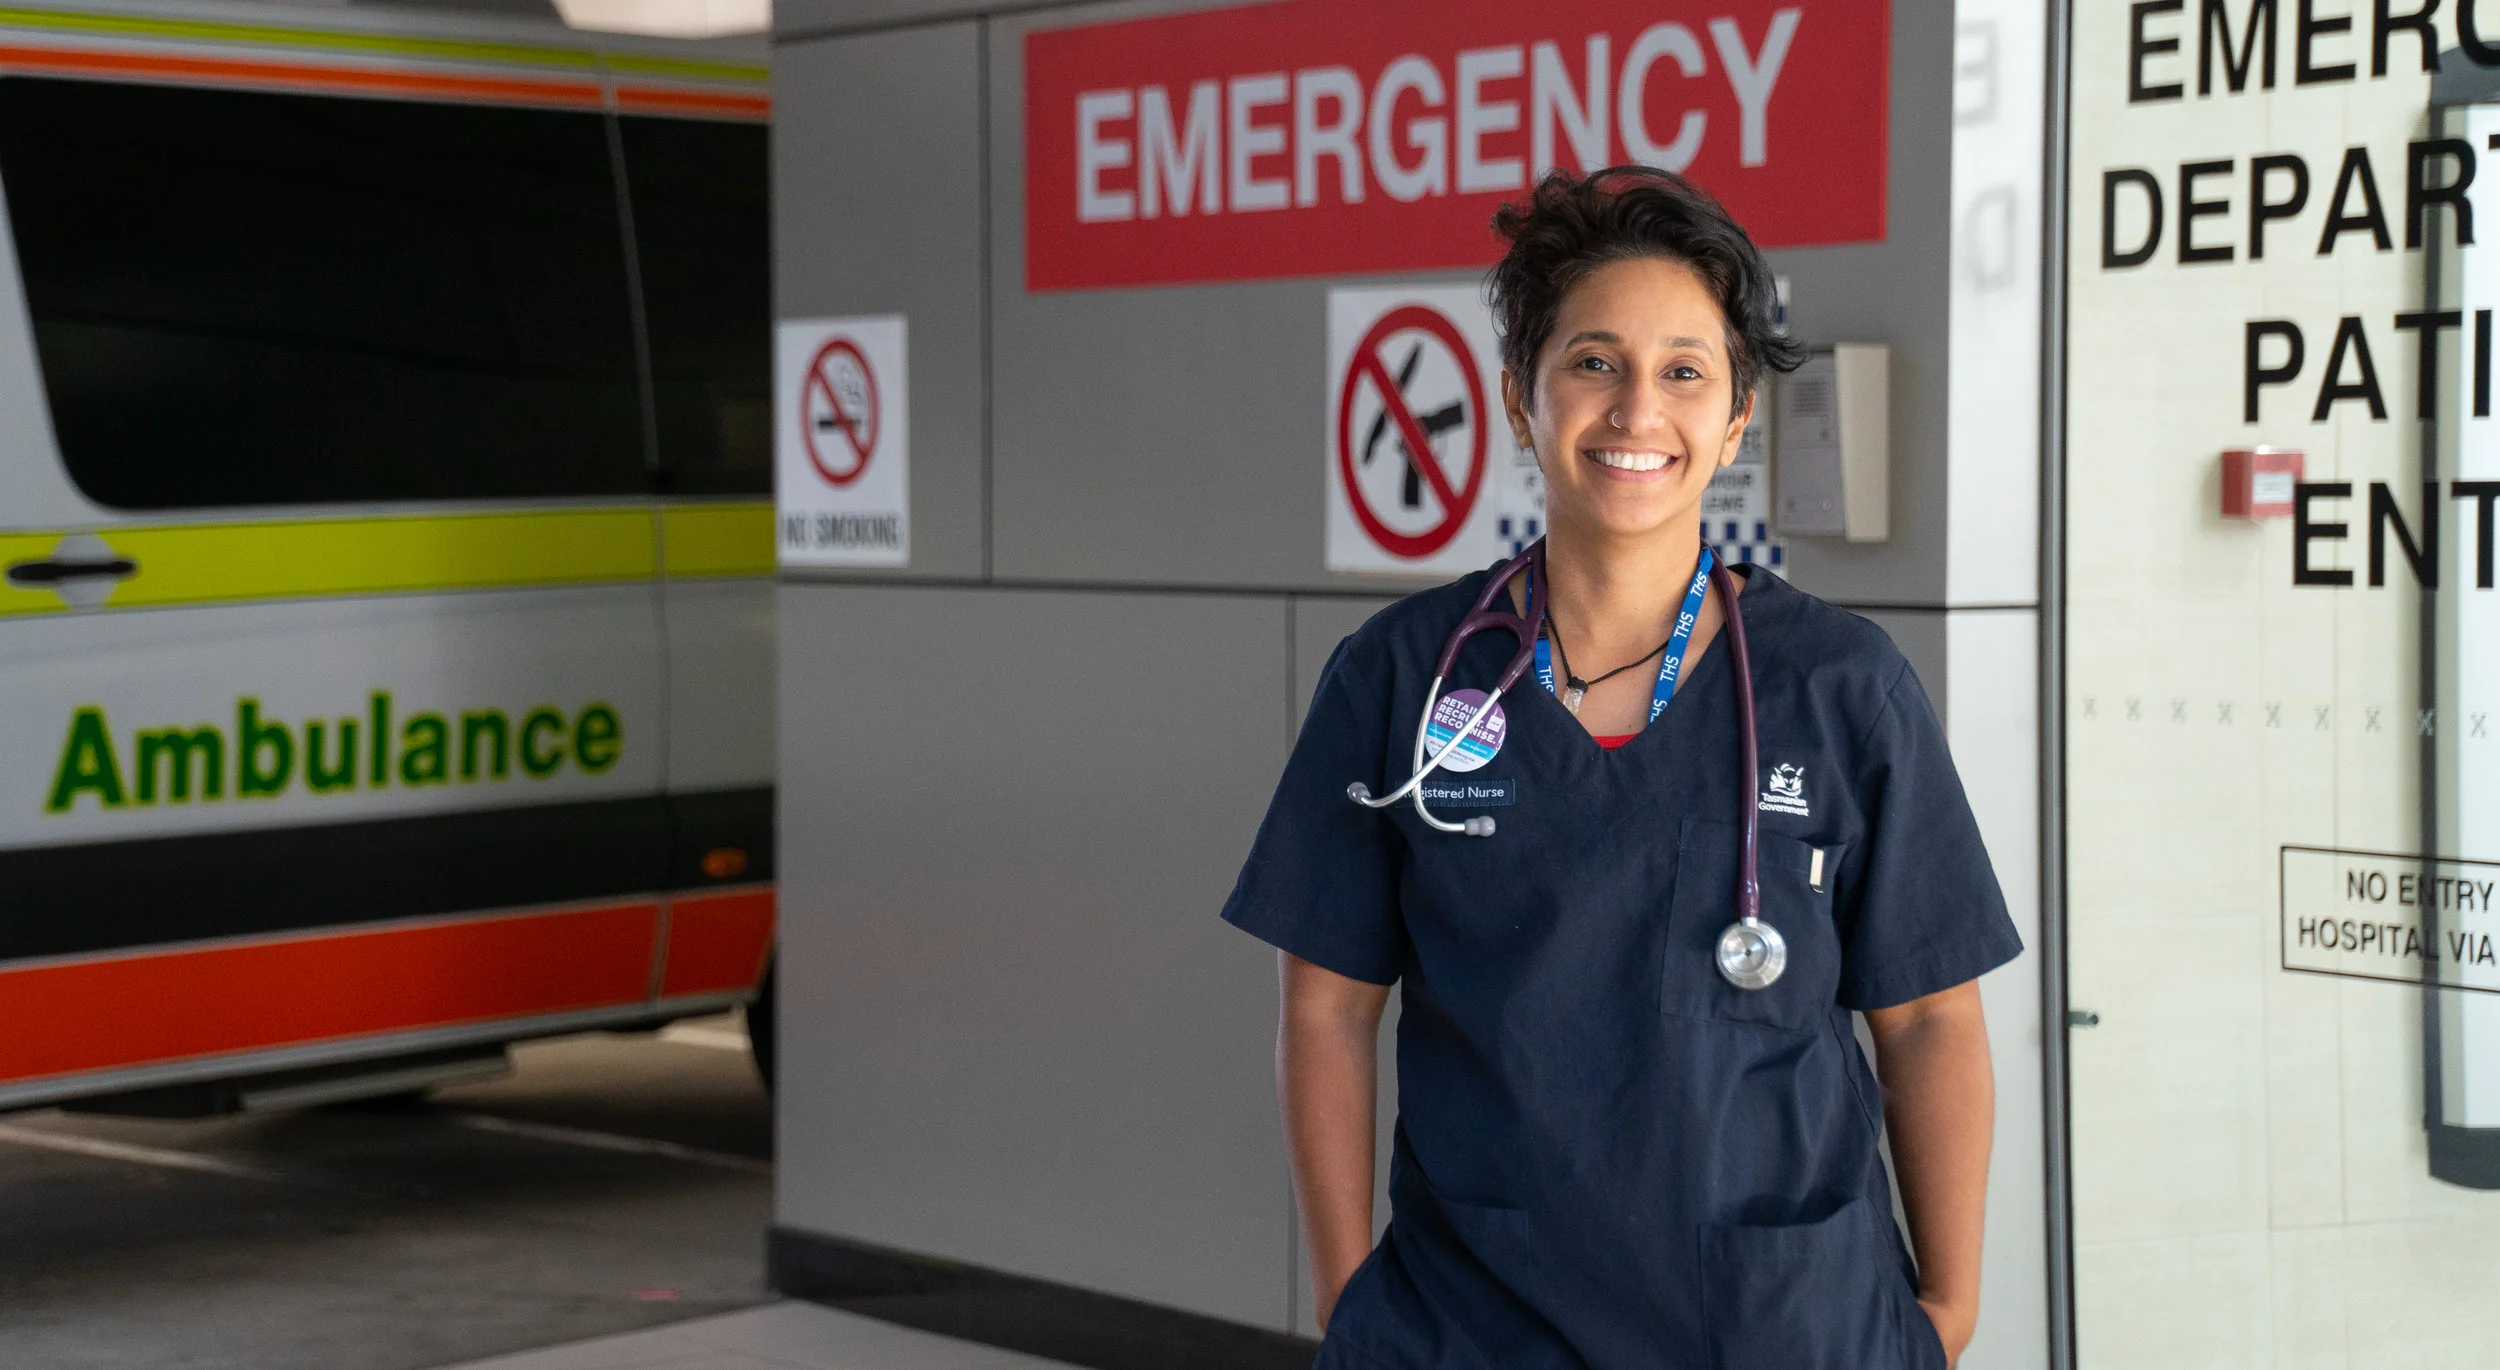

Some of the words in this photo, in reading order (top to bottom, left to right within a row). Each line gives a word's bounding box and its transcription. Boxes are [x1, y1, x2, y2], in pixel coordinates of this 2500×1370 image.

[1076, 8, 1802, 223] EMERGENCY
[2101, 133, 2500, 270] DEPAR
[2244, 309, 2492, 422] PATI
[2293, 480, 2500, 588] ENT
[1690, 571, 1707, 597] THS
[1674, 611, 1694, 638] THS
[1660, 655, 1679, 681] THS
[1434, 712, 1496, 744] RECONISE.
[1438, 704, 1484, 729] RECRT.
[46, 688, 624, 814] Ambulance
[1404, 787, 1464, 801] gistered
[1468, 786, 1504, 799] Nurse
[1758, 801, 1809, 817] Government
[1761, 792, 1806, 807] Tasmanian
[2347, 871, 2387, 902] NO
[2399, 874, 2494, 912] ENTRY
[2299, 916, 2439, 961] HOSPITAL
[2448, 931, 2496, 966] VIA
